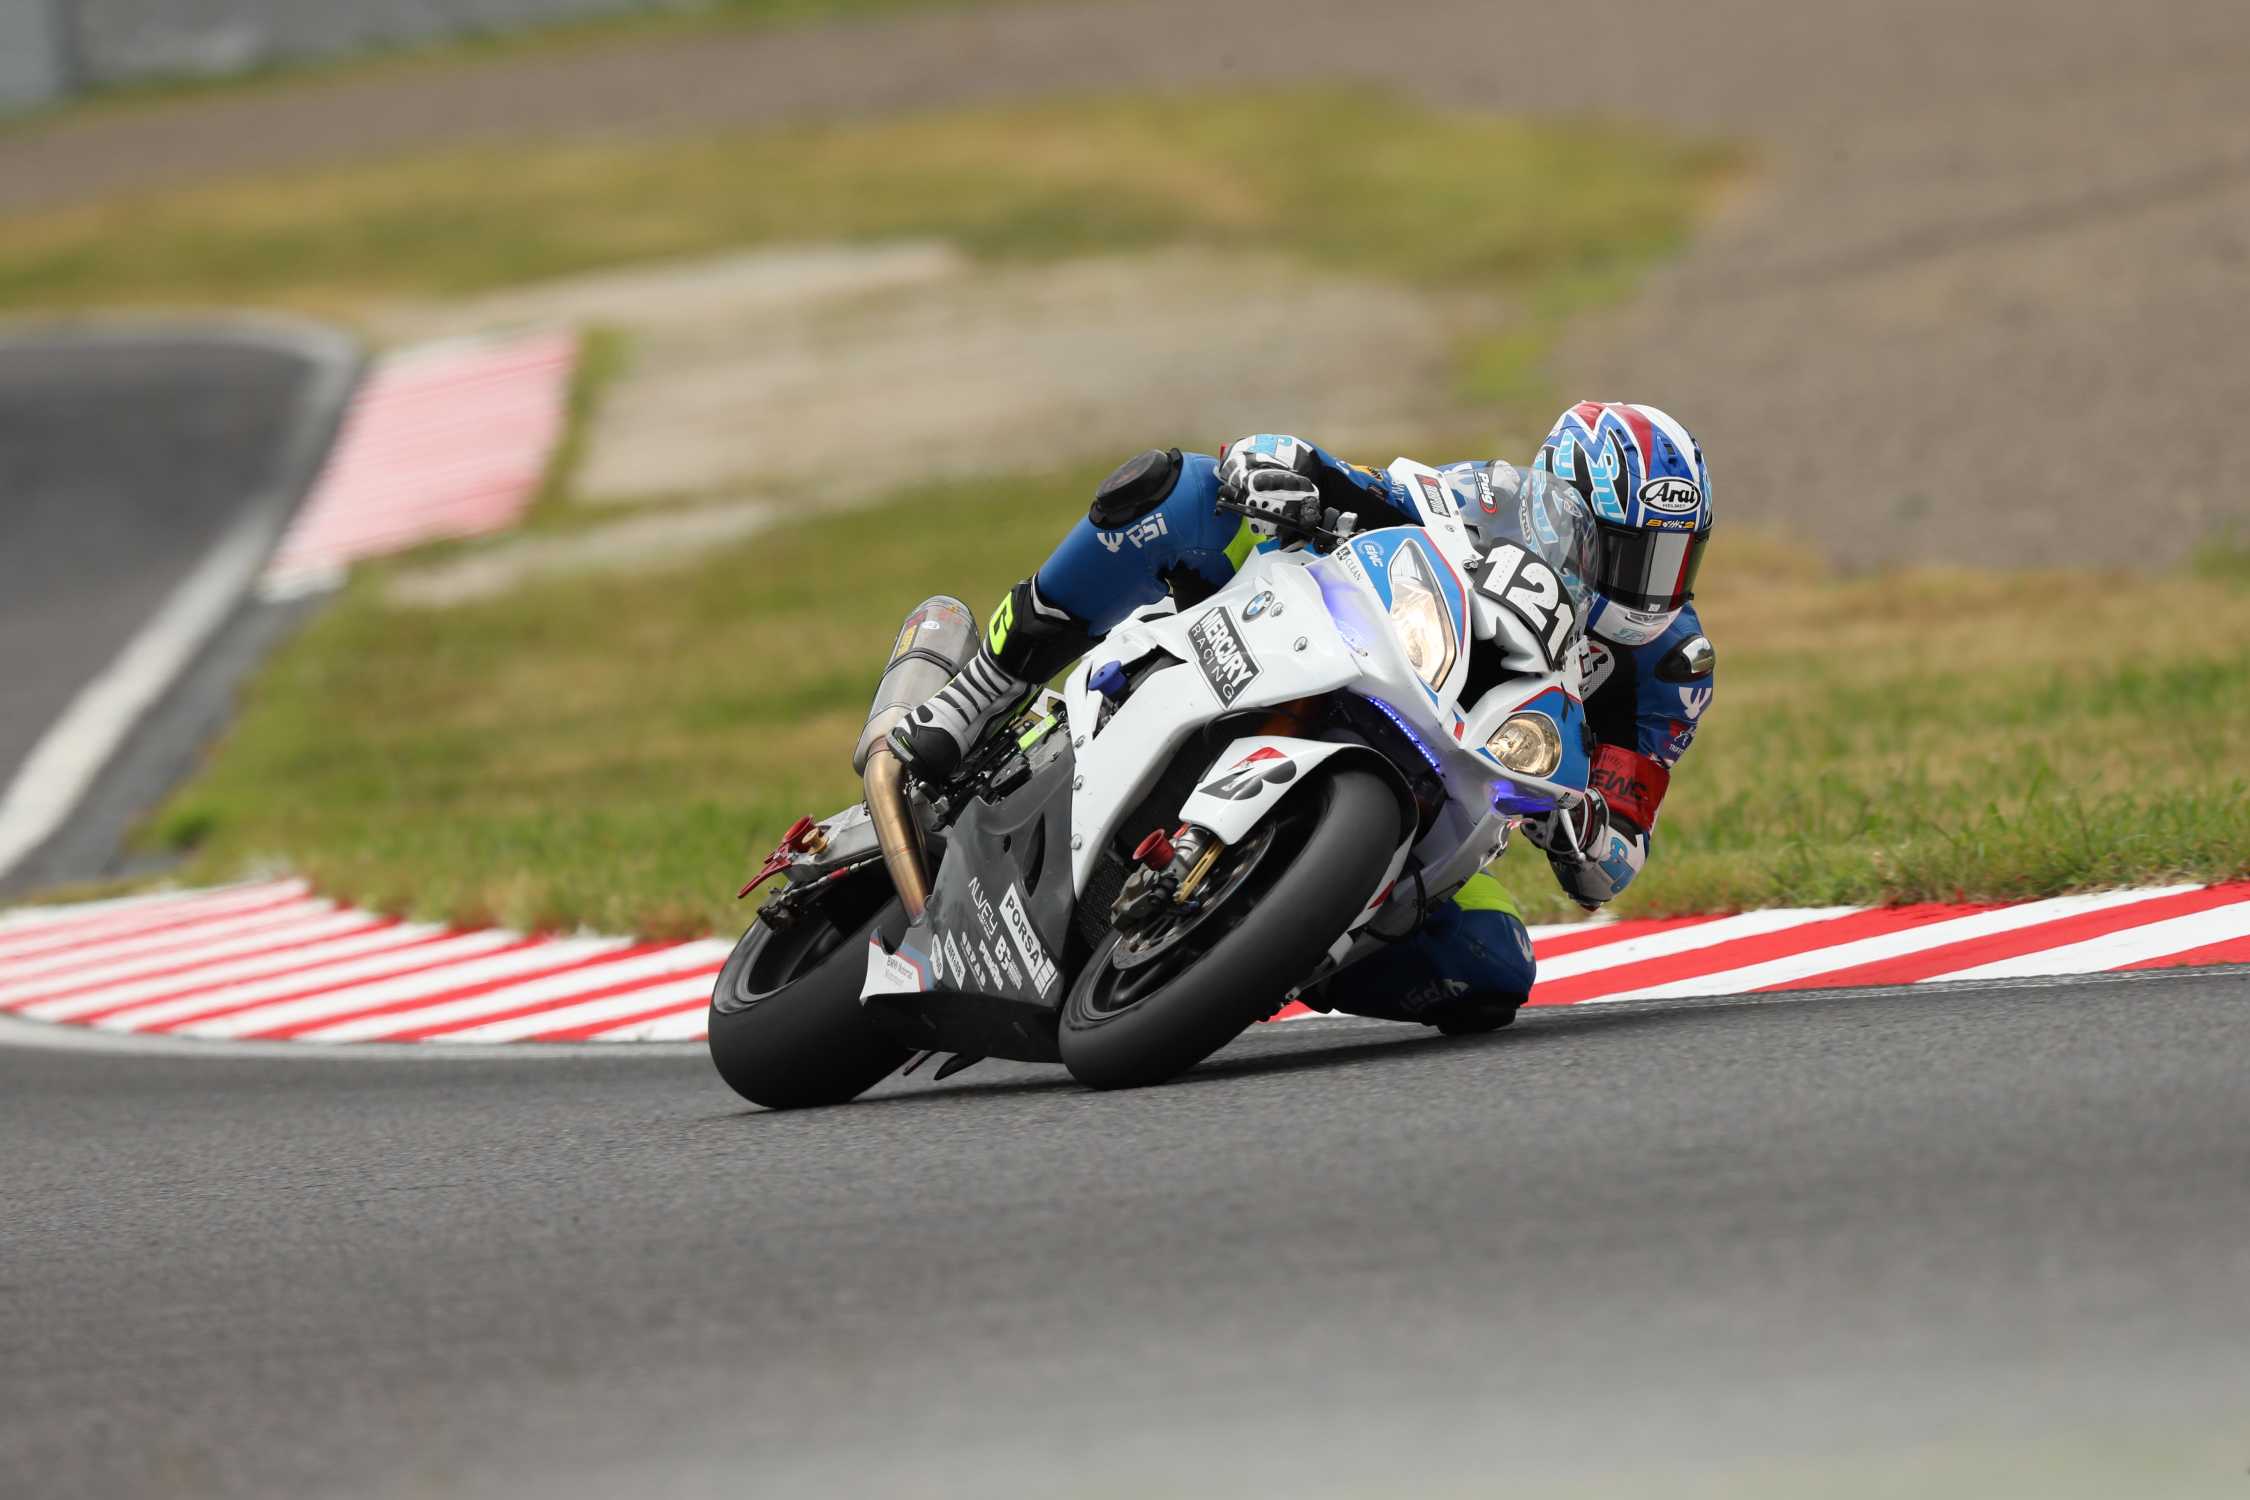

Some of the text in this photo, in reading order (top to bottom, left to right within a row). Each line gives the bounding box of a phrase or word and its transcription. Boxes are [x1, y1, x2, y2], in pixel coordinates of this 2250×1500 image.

[1478, 472, 1495, 505] Puig
[1646, 482, 1696, 503] Arai
[1482, 544, 1574, 662] 121
[1192, 624, 1235, 700] RACING
[1201, 607, 1254, 688] MERCURY
[1005, 896, 1040, 967] PORSA
